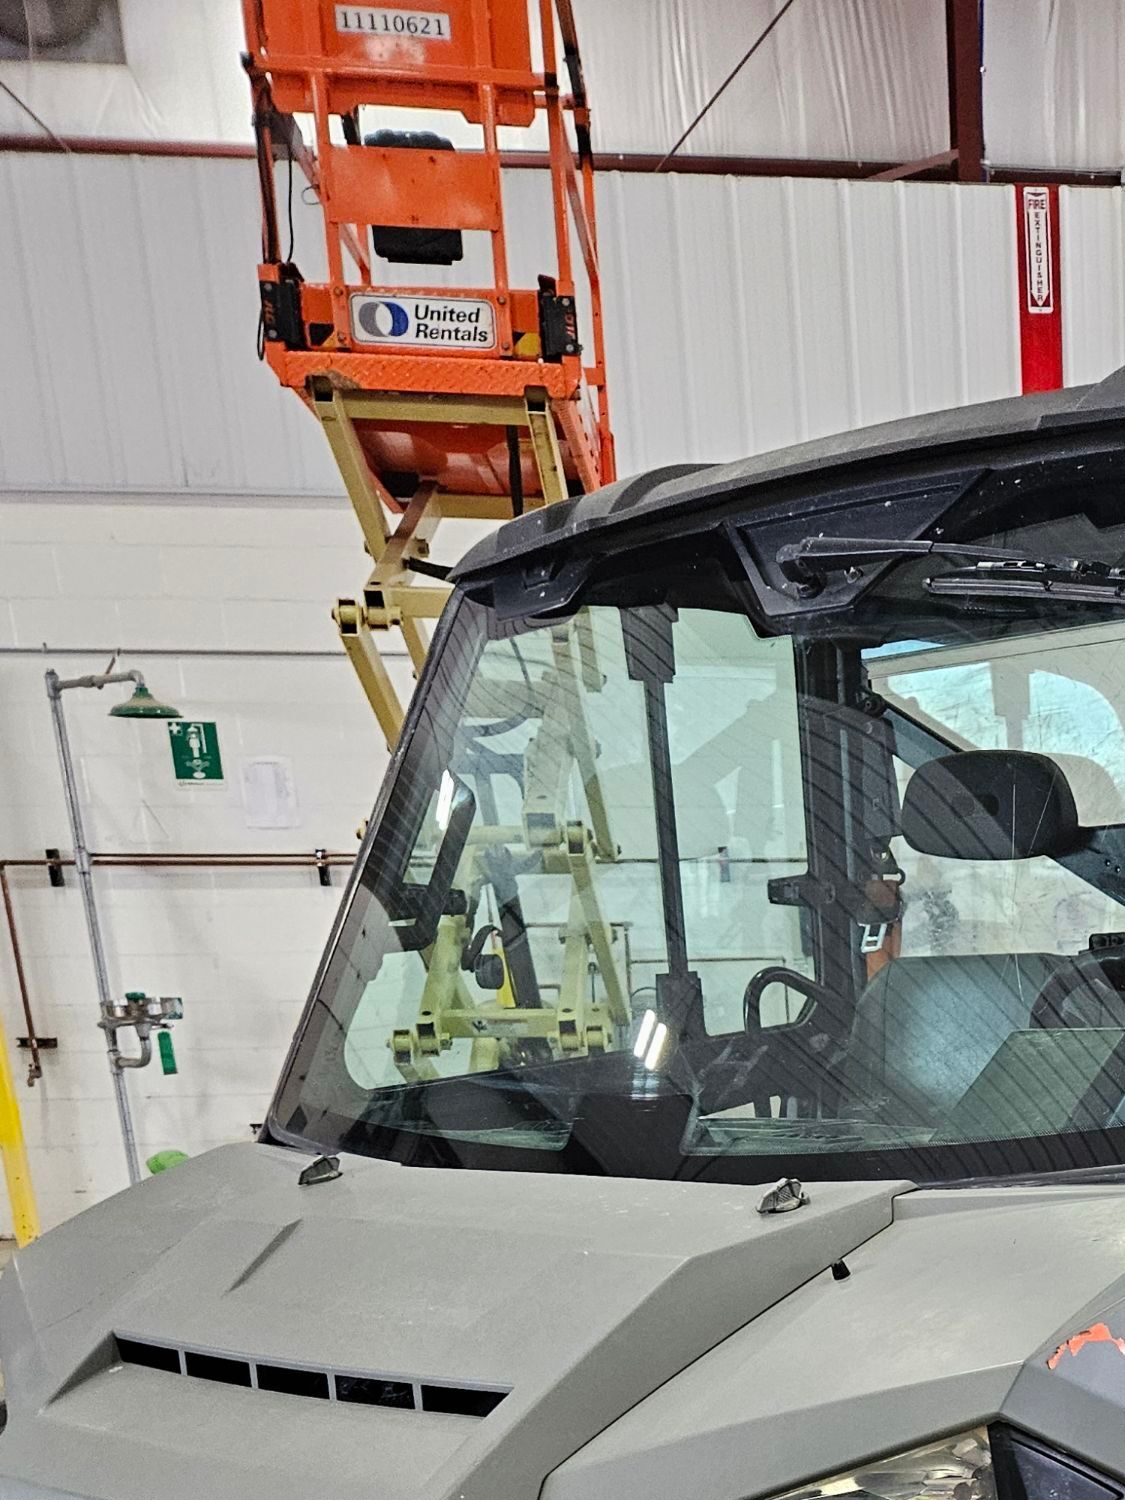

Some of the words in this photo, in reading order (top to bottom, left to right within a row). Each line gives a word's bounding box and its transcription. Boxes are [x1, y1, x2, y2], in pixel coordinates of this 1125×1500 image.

[341, 11, 444, 36] 11110621
[1028, 199, 1046, 210] FIRE
[1034, 211, 1044, 302] EXTINGUISHER
[414, 304, 481, 323] United
[415, 323, 488, 342] Rentals
